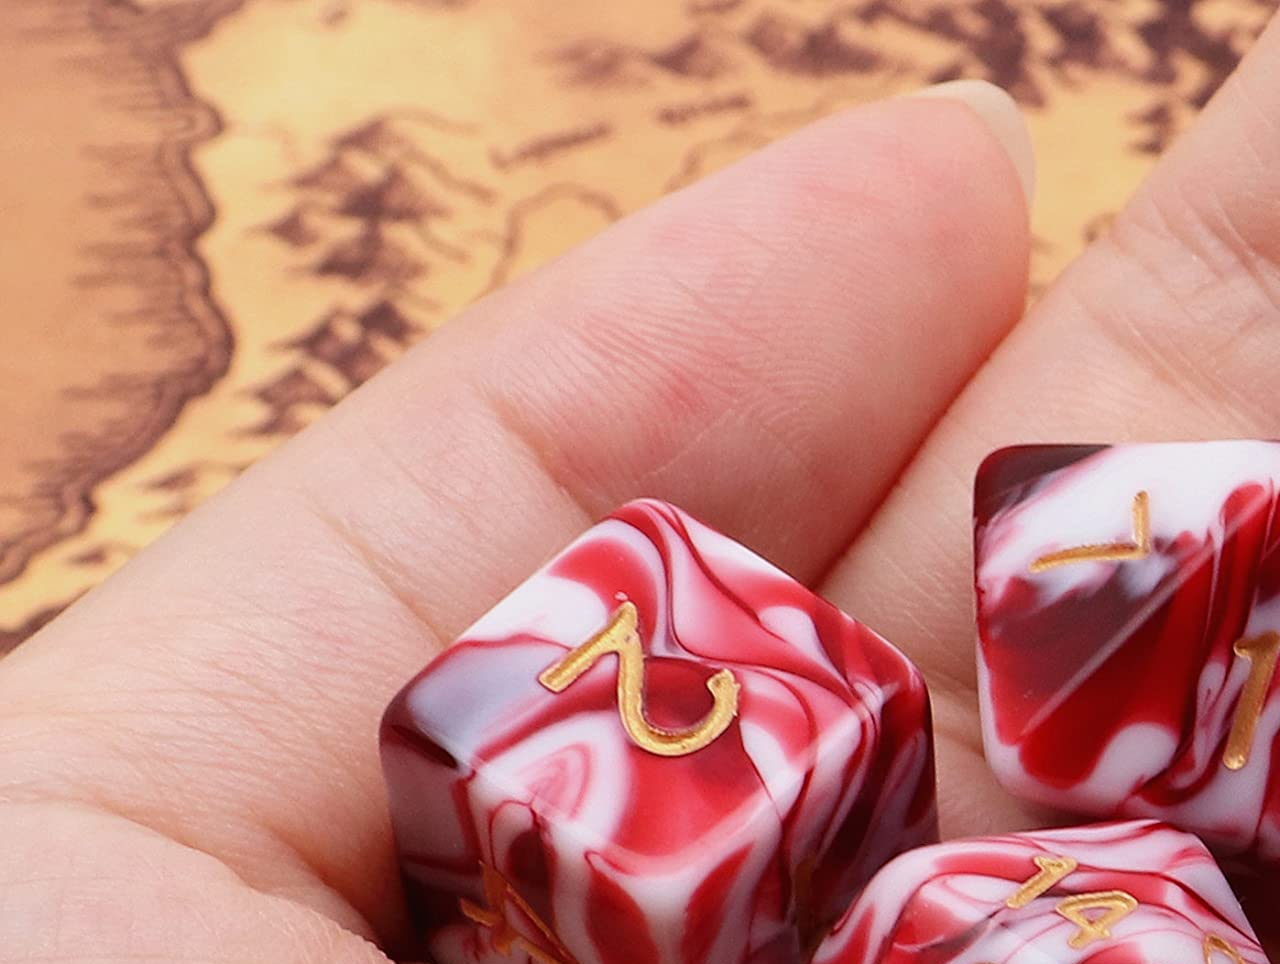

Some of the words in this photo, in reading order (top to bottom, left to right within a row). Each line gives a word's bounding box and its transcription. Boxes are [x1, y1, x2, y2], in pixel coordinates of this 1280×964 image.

[1030, 490, 1149, 573] 7
[538, 600, 741, 757] 2
[1222, 631, 1280, 770] 1
[1006, 855, 1138, 949] 14
